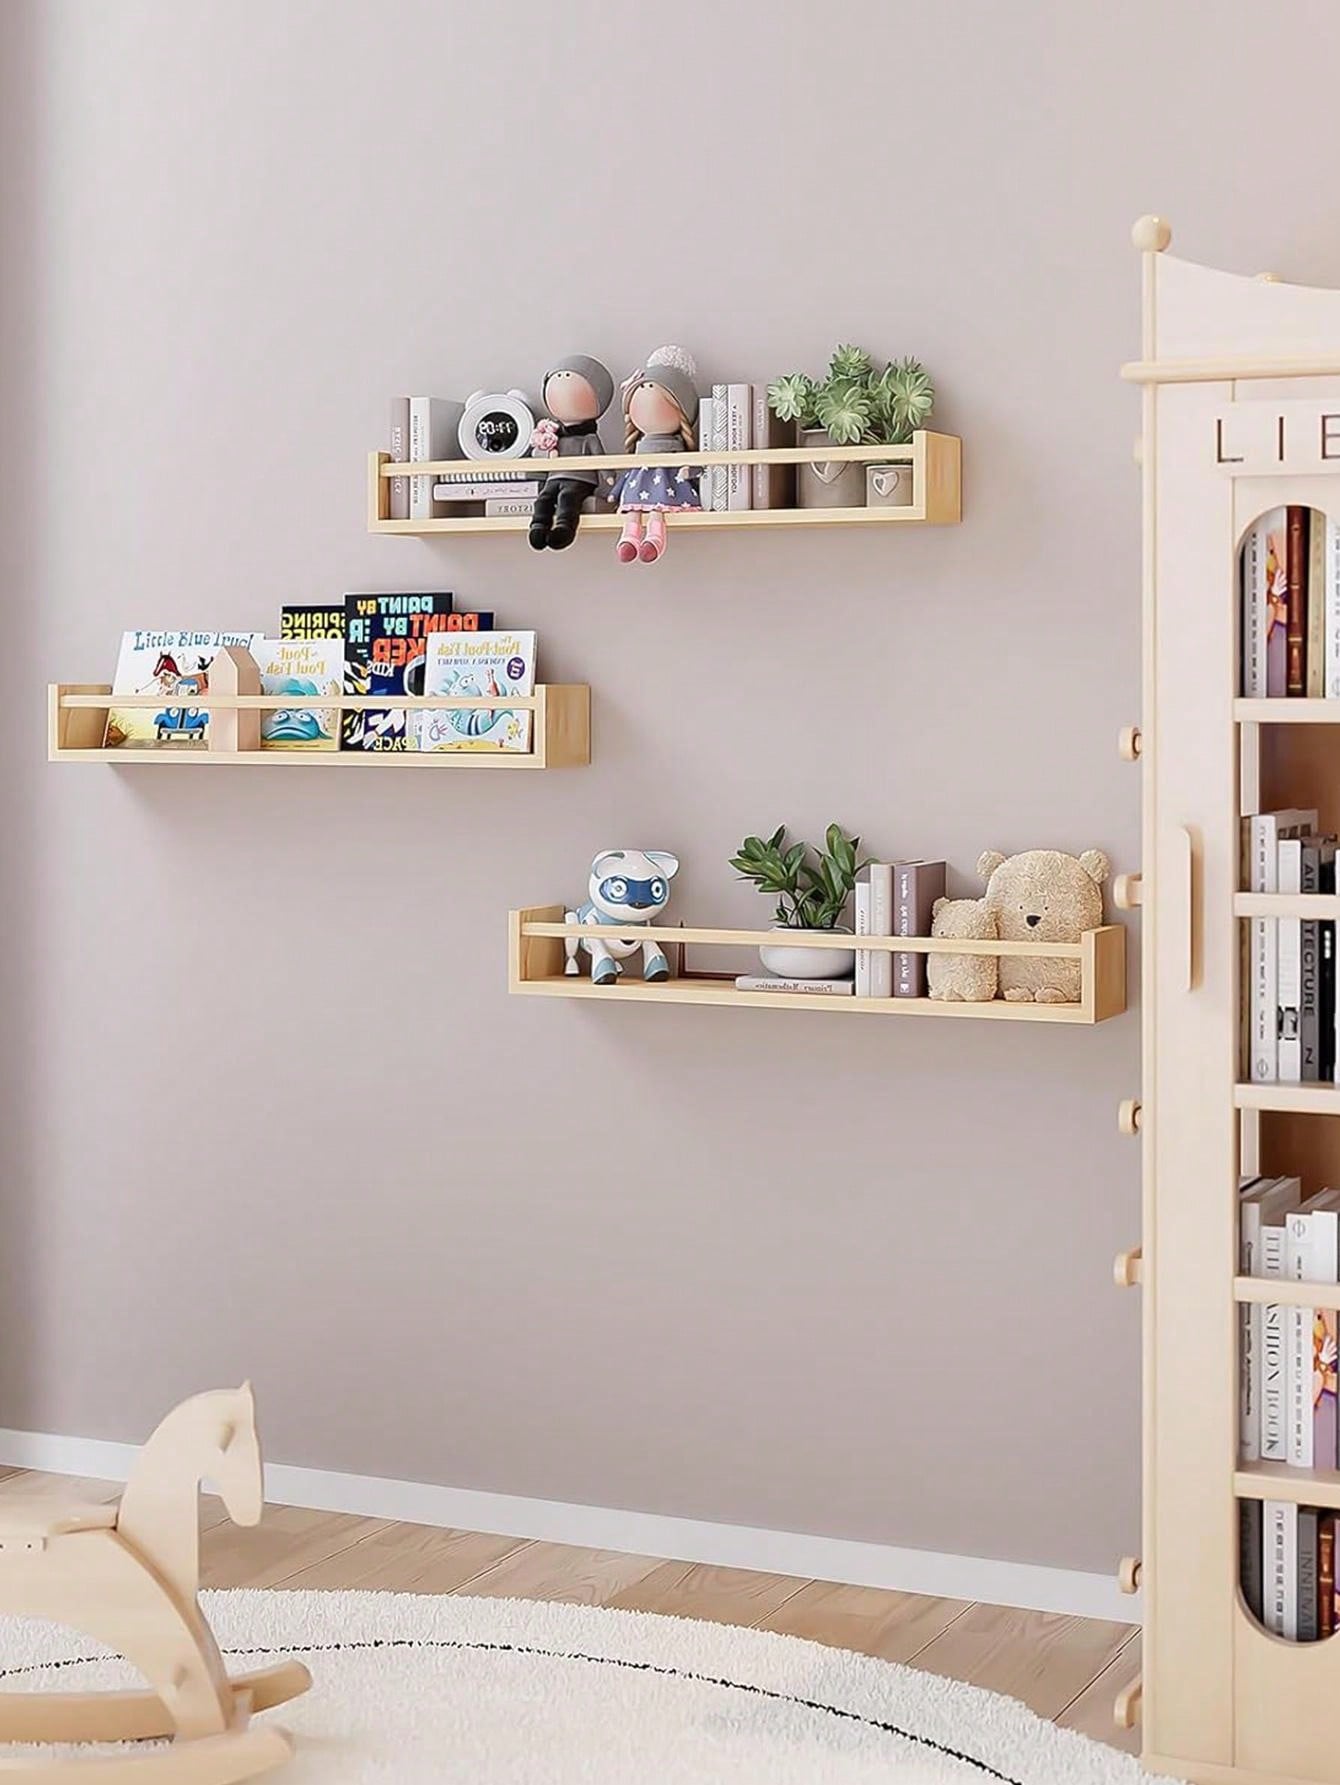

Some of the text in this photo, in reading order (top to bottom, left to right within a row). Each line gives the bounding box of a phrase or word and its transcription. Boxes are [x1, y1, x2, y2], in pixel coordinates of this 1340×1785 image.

[133, 631, 174, 651] Little
[178, 631, 211, 647] Blue
[1304, 864, 1315, 1016] ARITECTURE
[1266, 1302, 1280, 1381] ASHION
